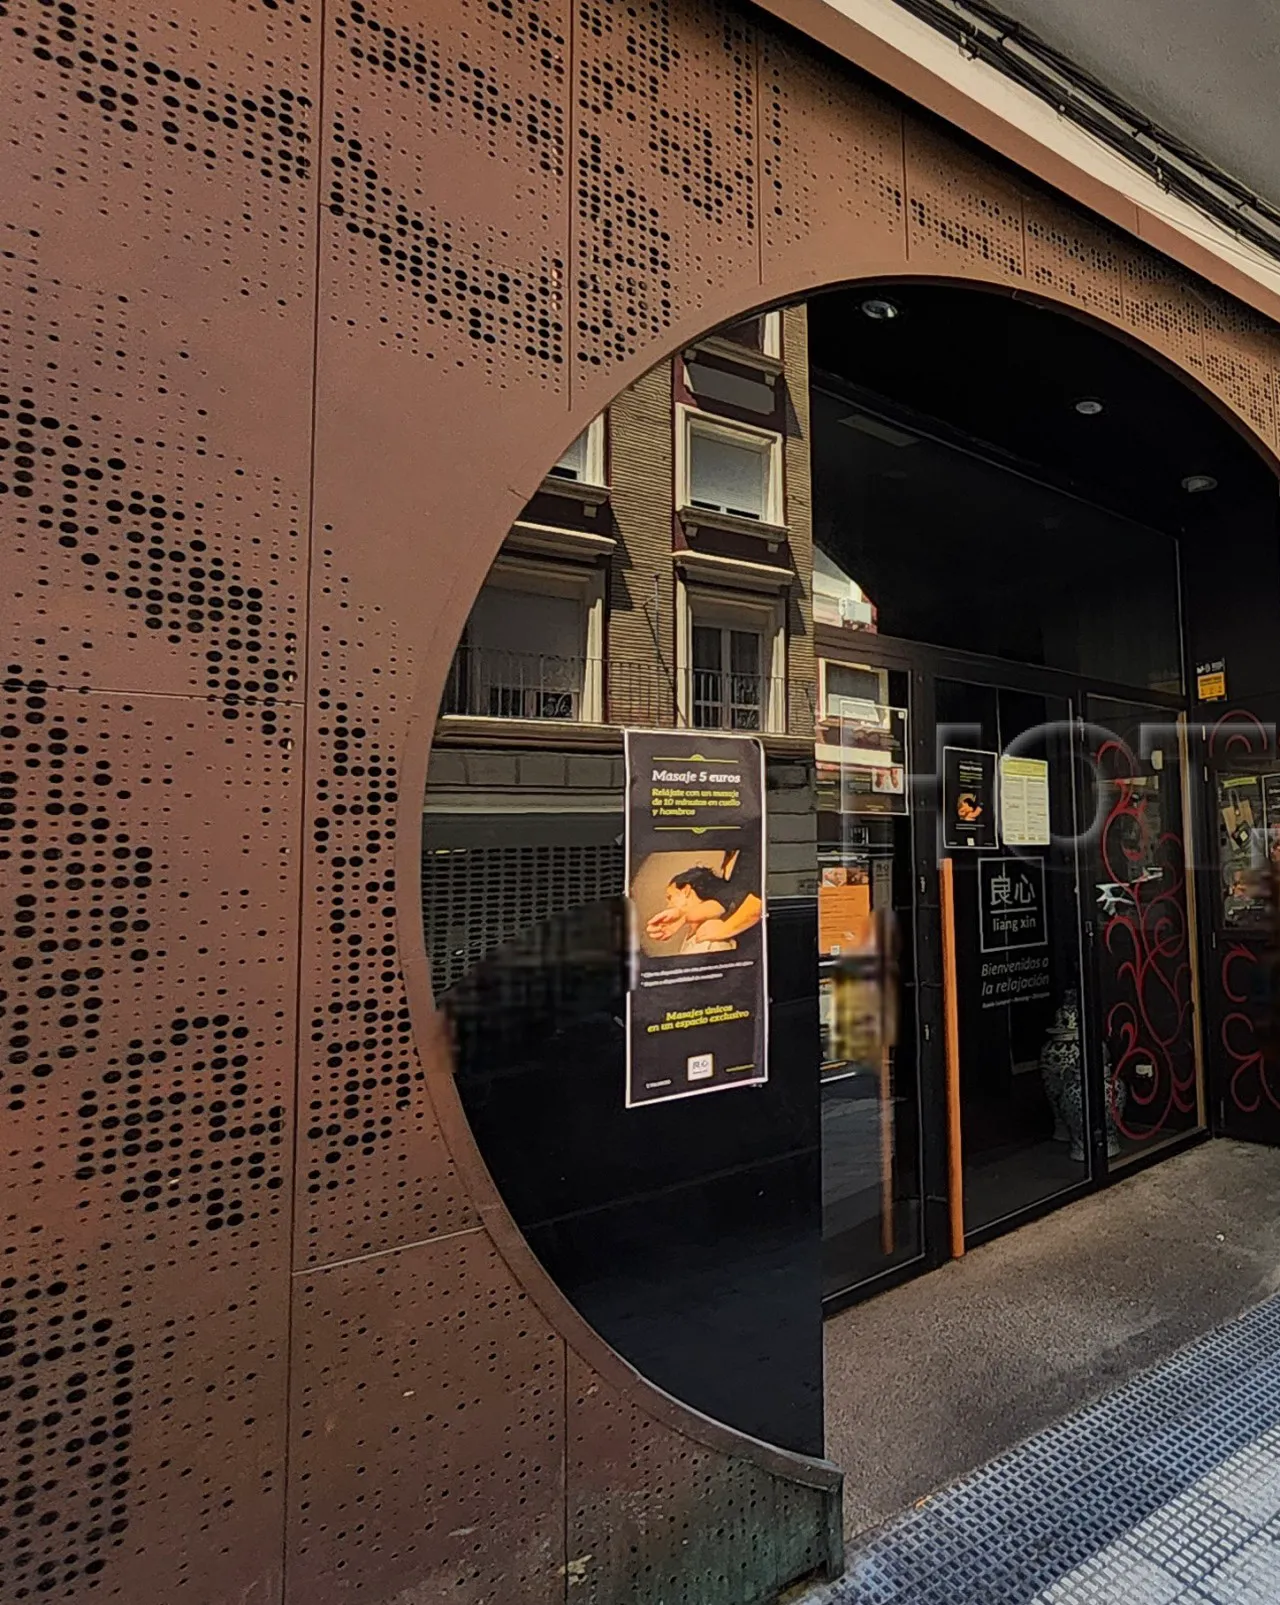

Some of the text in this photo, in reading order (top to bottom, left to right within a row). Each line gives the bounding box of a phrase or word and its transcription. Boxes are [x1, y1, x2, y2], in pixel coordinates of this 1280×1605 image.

[651, 769, 742, 784] Masaje 5 euros
[651, 798, 663, 806] de
[659, 807, 696, 816] hombros
[990, 873, 1036, 906] 良心
[992, 914, 1037, 932] liang xin
[981, 957, 1049, 977] Bienvenidos a
[981, 972, 1050, 997] la relajación
[646, 1009, 750, 1033] en un espacio exclusivo
[664, 1004, 734, 1022] Masajes únicos
